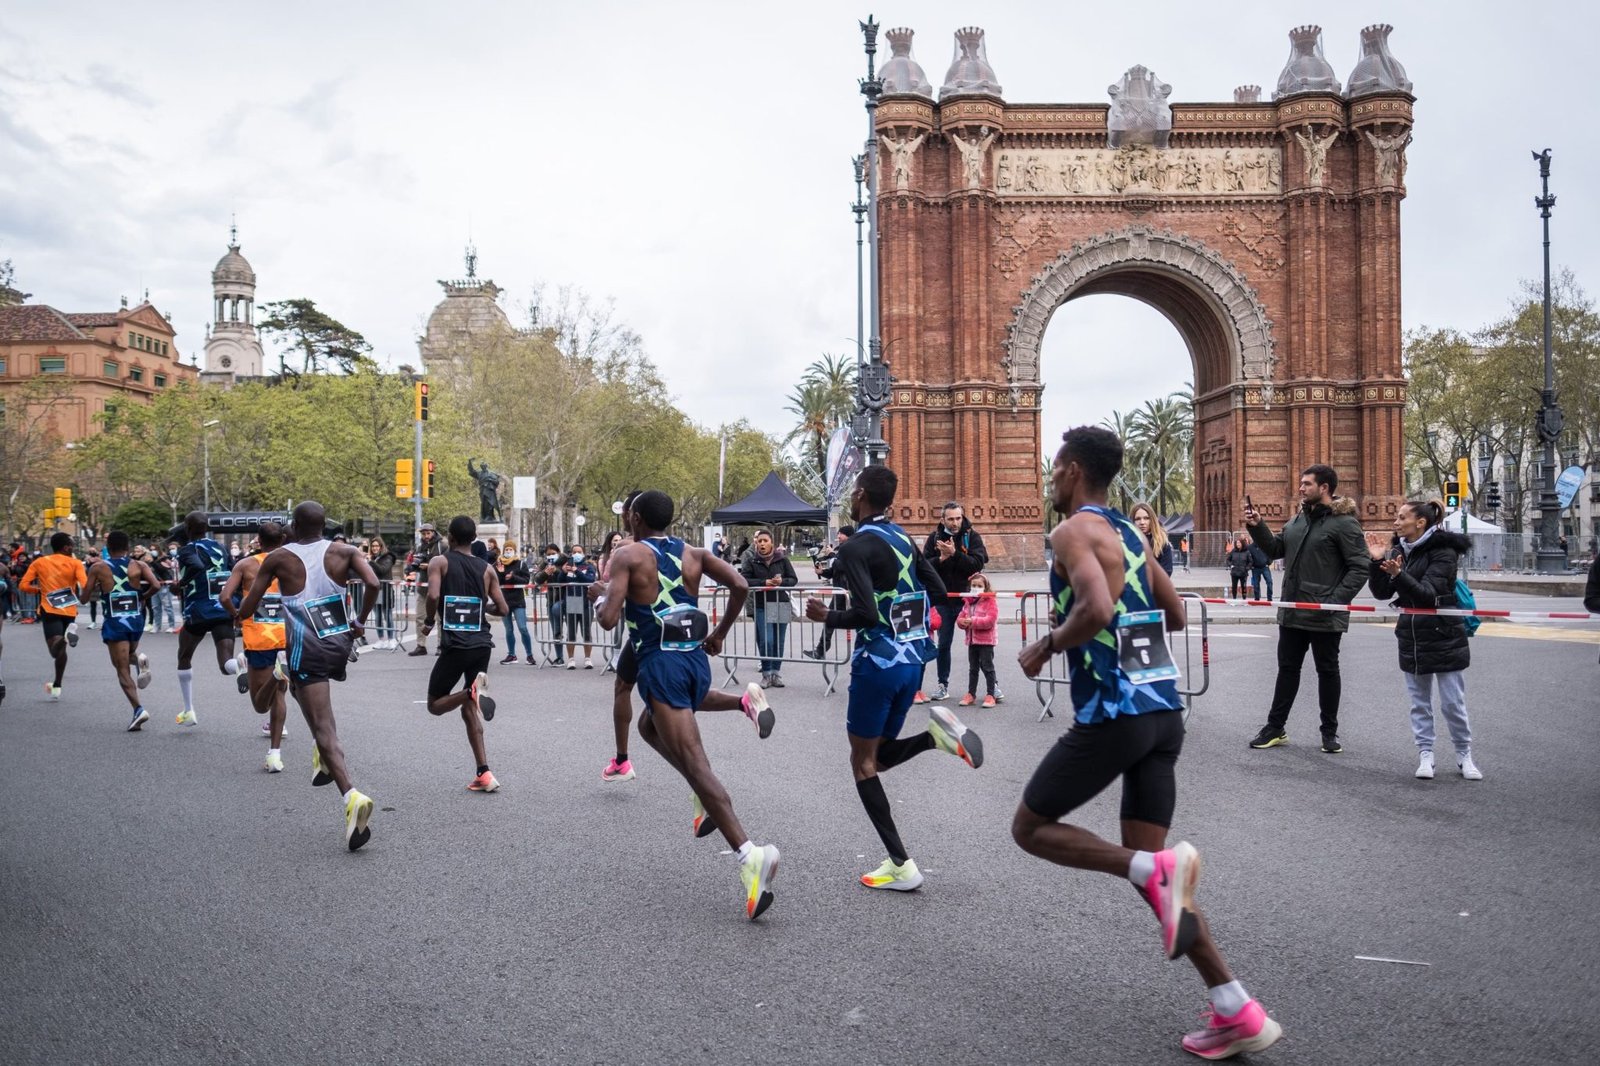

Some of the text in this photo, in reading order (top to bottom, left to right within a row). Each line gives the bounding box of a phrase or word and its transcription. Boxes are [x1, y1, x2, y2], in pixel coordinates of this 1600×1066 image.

[207, 516, 288, 527] LIDERGRI
[905, 618, 910, 629] 1
[686, 628, 691, 639] 1
[1140, 649, 1150, 665] 6
